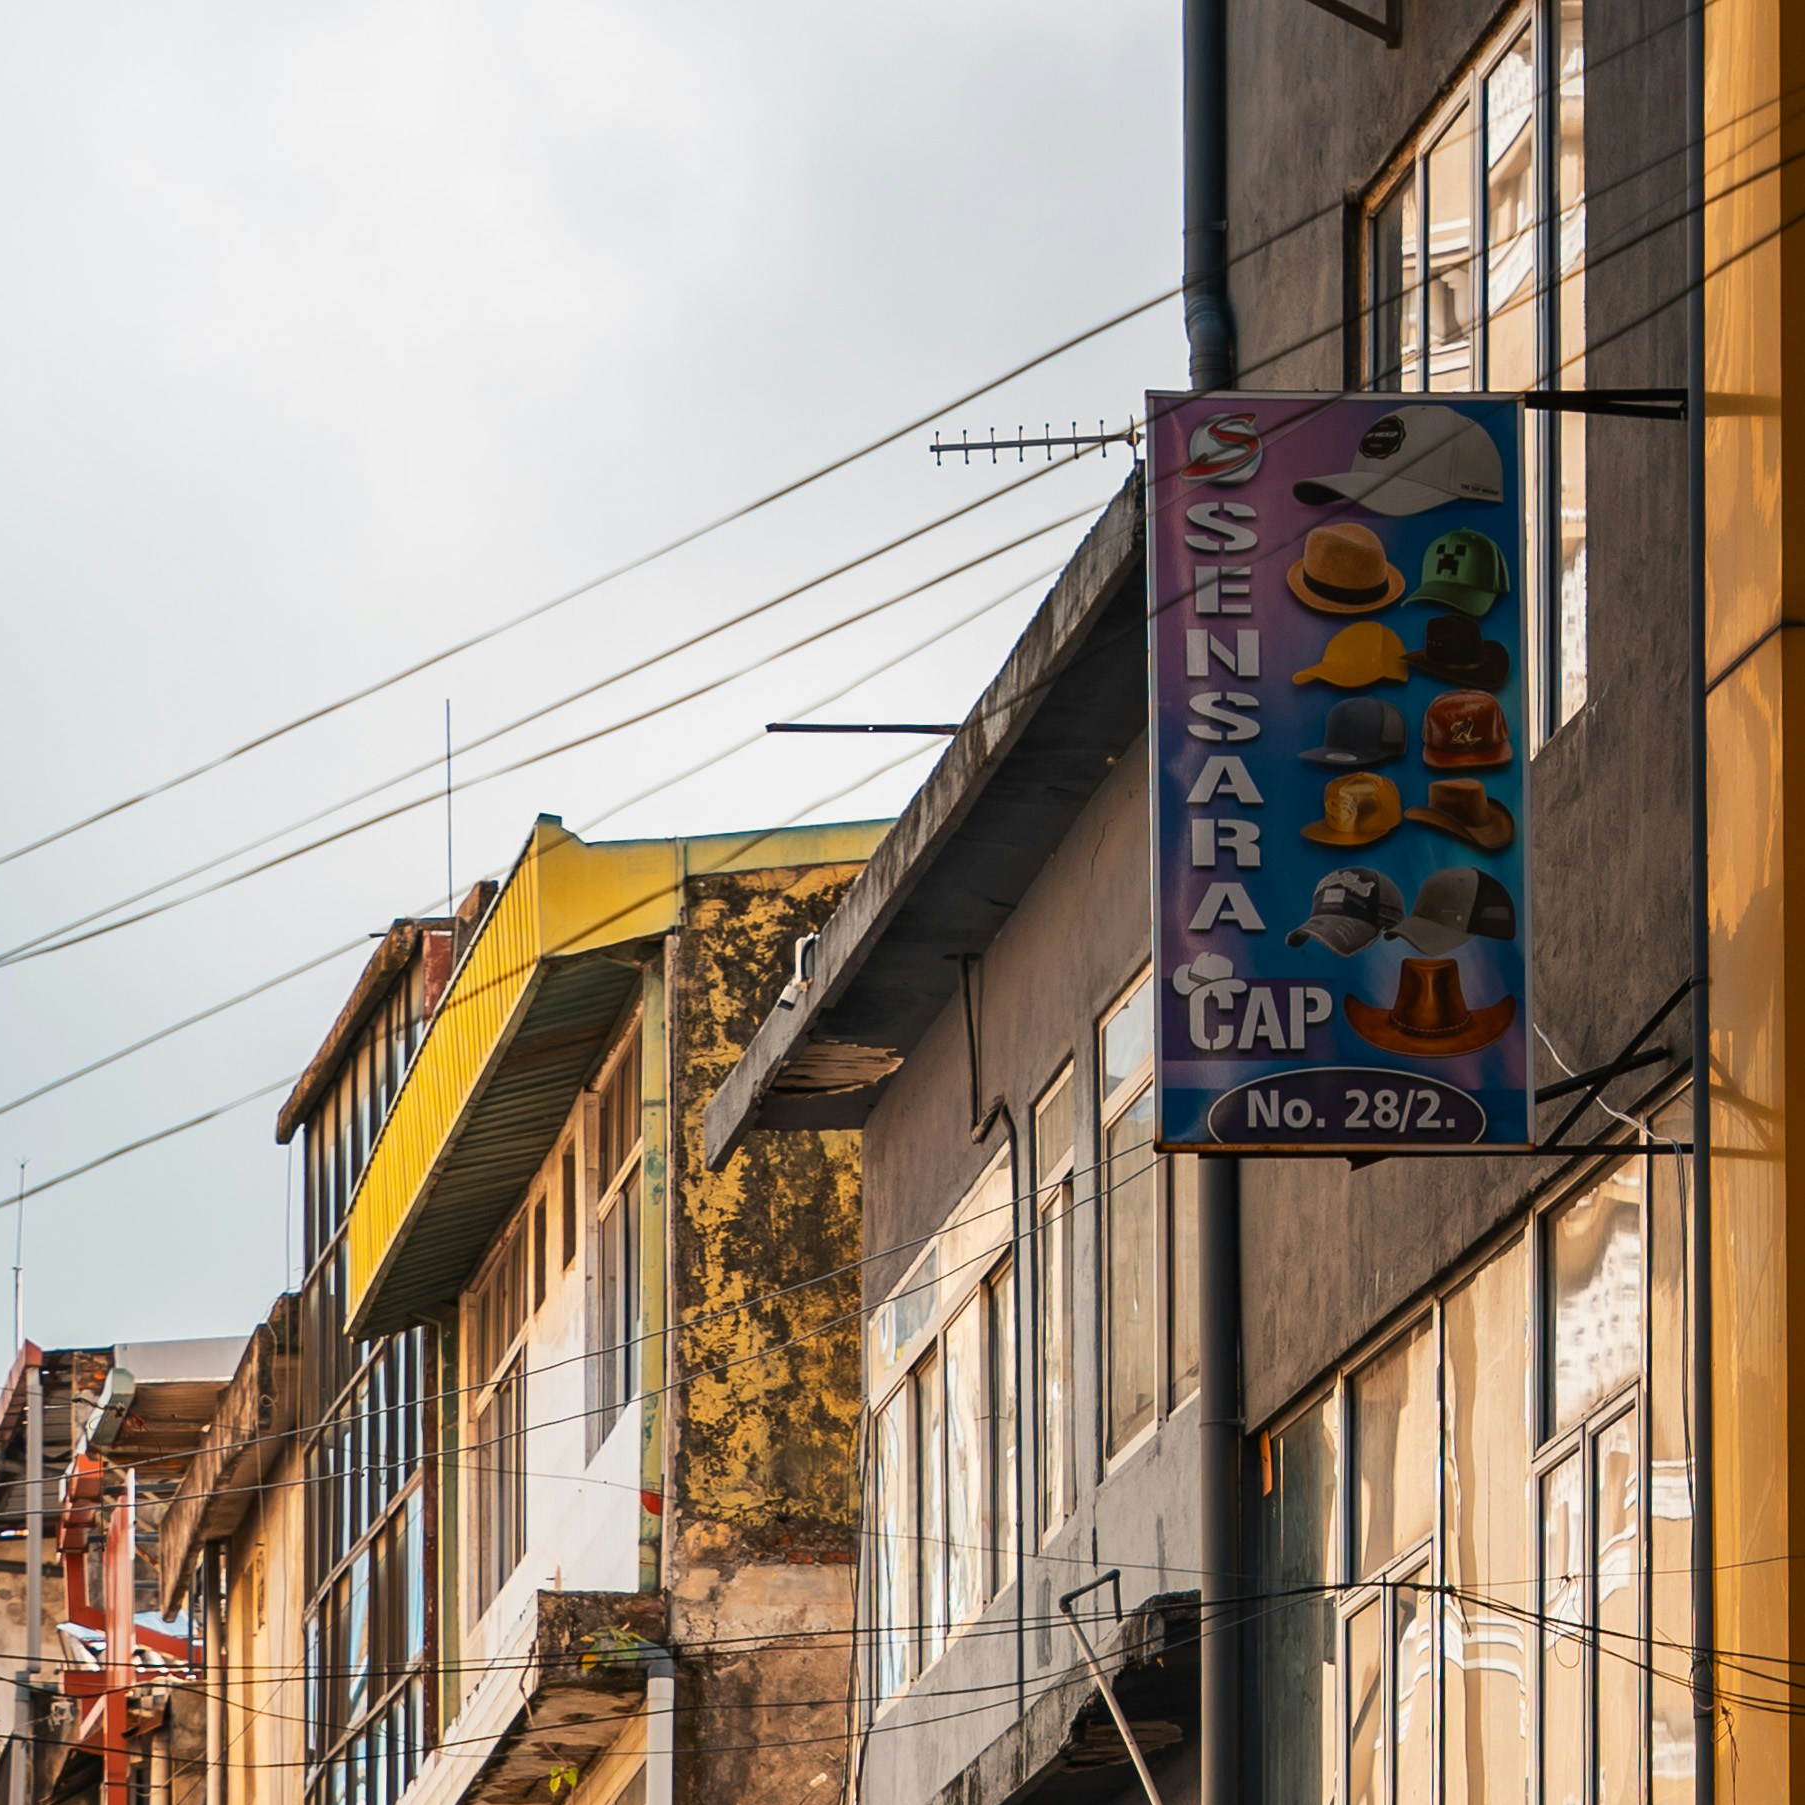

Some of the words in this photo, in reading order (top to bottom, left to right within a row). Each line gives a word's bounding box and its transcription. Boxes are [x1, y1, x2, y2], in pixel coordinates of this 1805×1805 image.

[1183, 500, 1267, 932] SENSARA
[1189, 975, 1334, 1052] CAP
[1246, 1091, 1326, 1130] No.
[1342, 1091, 1456, 1133] 28/2.
